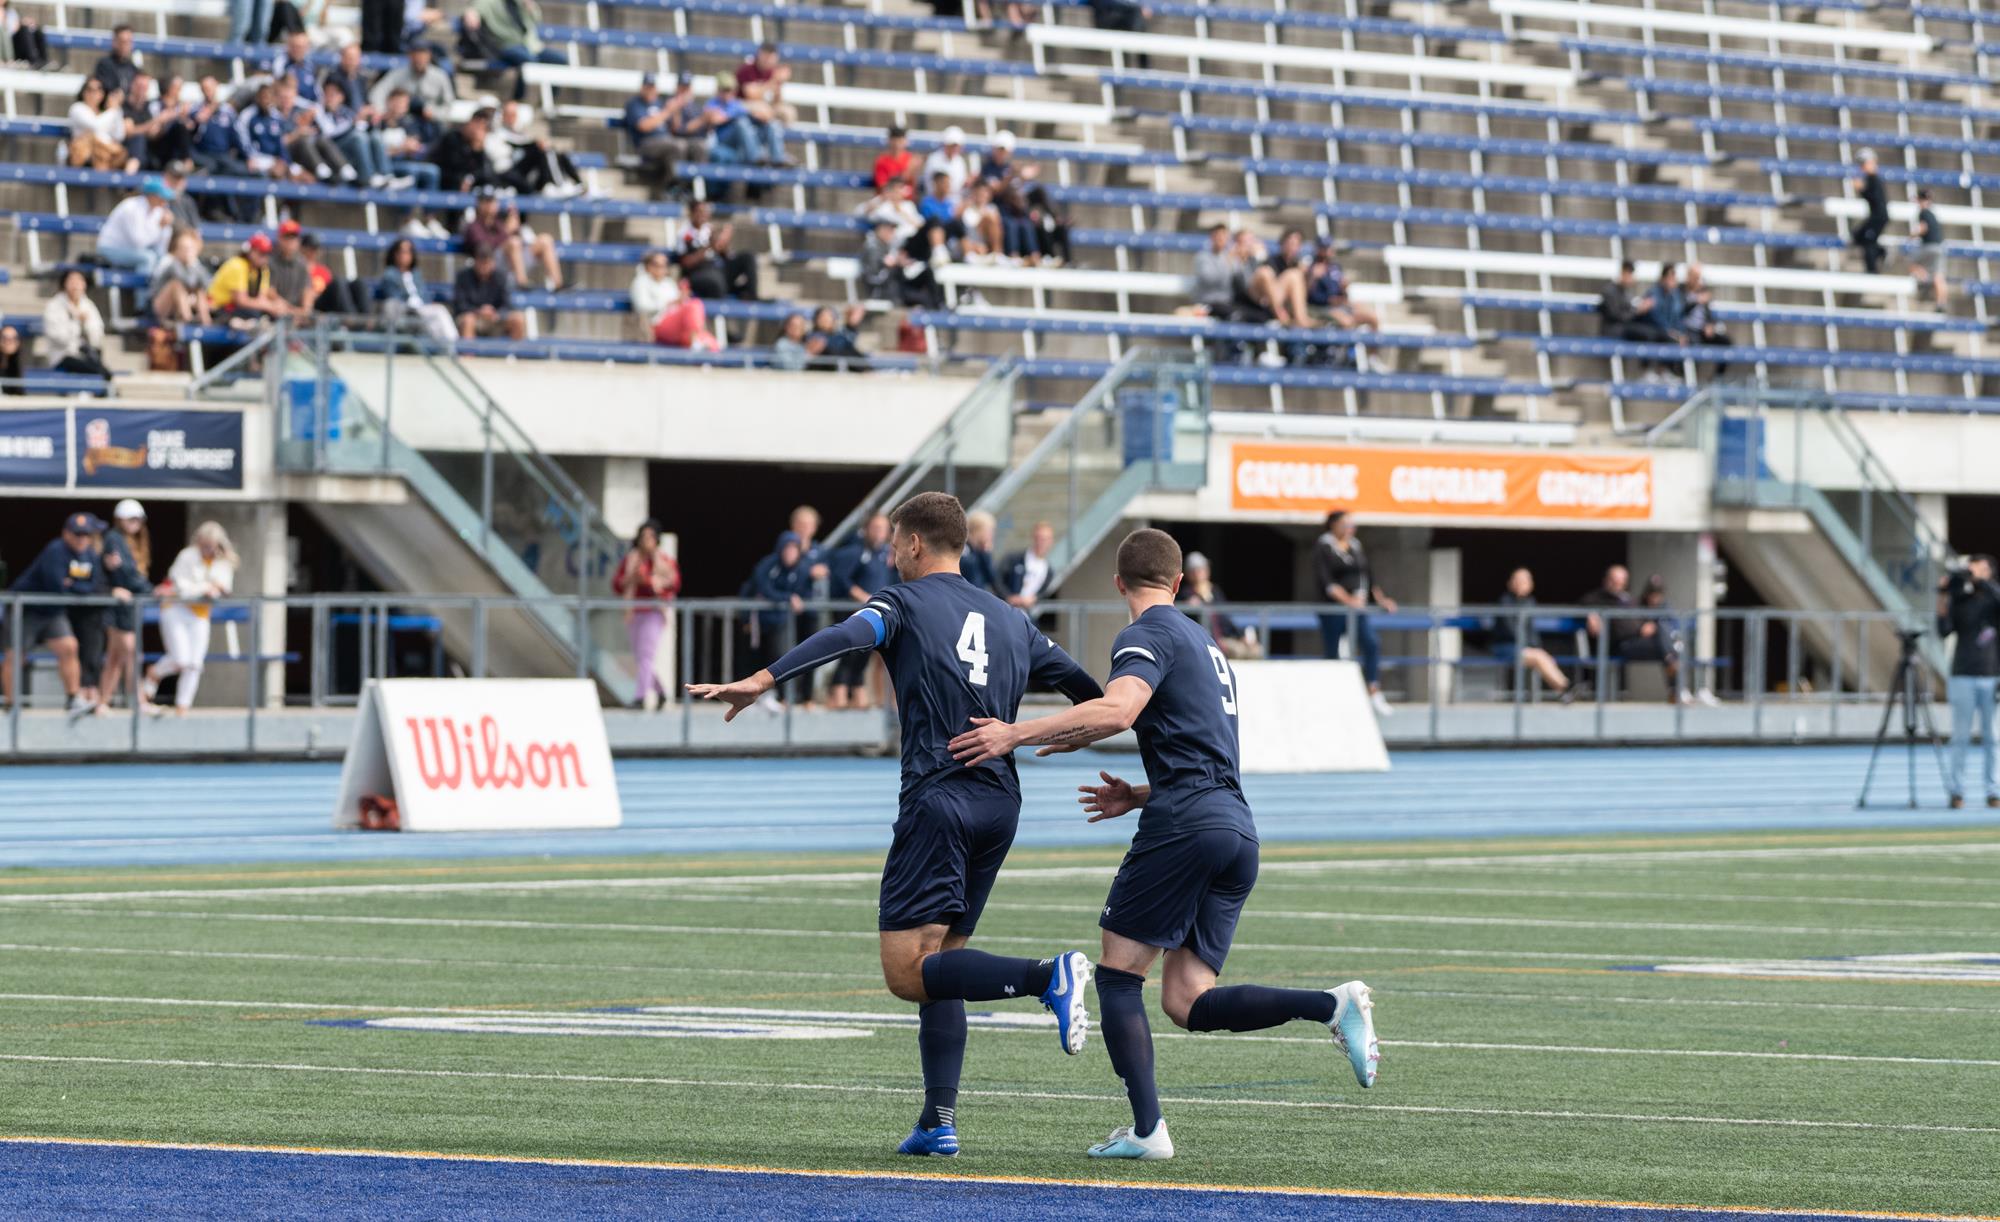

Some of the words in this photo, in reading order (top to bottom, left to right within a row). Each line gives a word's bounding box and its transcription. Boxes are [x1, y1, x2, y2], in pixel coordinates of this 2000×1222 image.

[1236, 460, 1358, 500] GATORADE
[1390, 465, 1507, 504] GATORADE
[1537, 470, 1650, 507] GATORADE
[956, 611, 989, 686] 4
[1206, 644, 1237, 716] 9
[405, 714, 588, 790] Wilson
